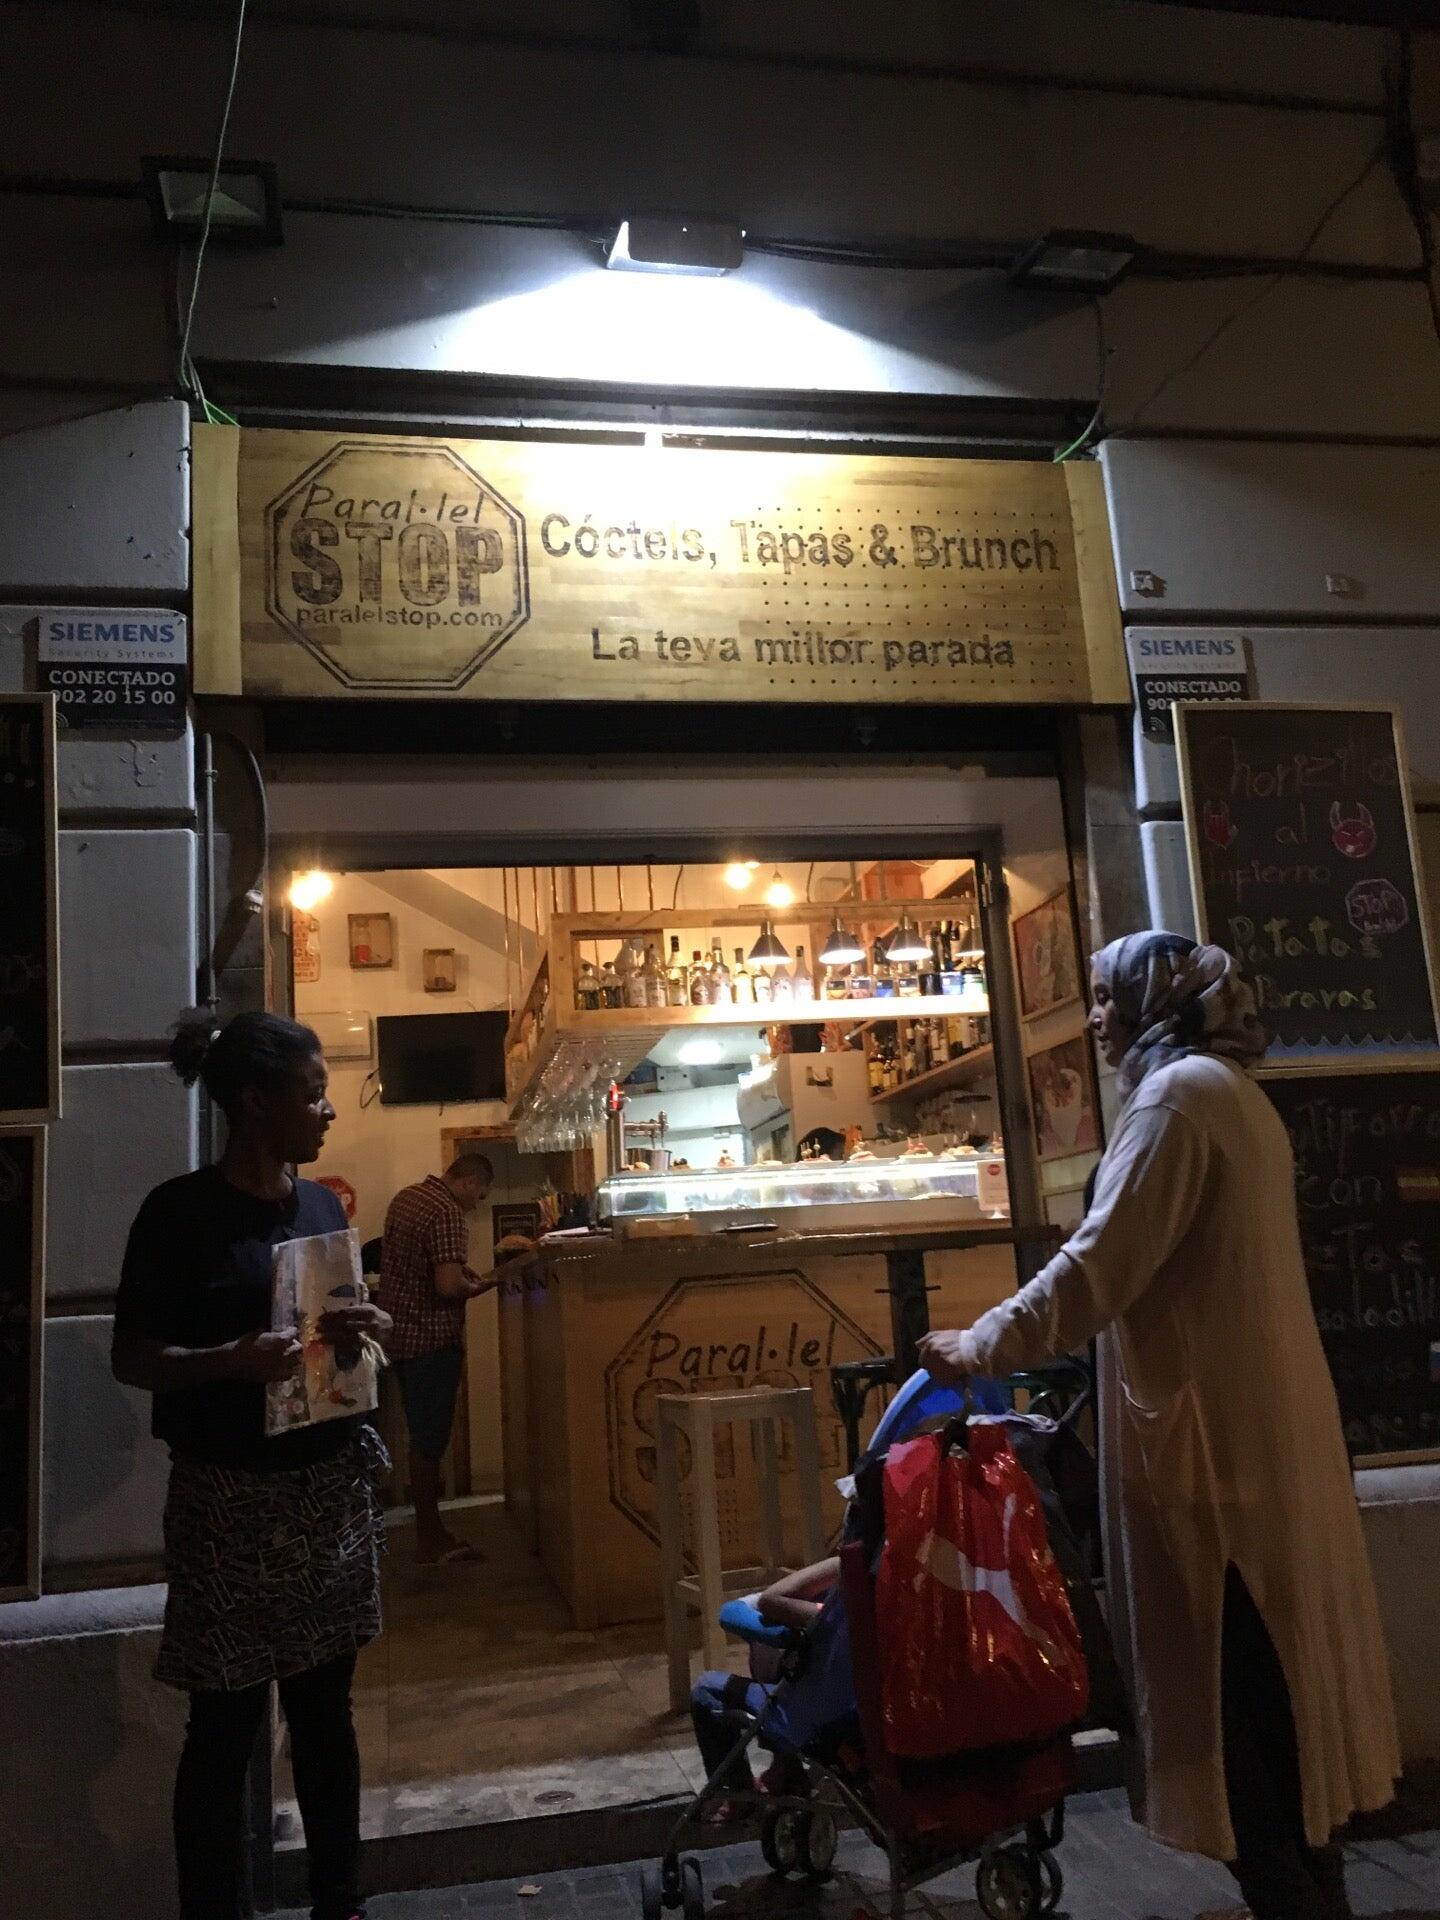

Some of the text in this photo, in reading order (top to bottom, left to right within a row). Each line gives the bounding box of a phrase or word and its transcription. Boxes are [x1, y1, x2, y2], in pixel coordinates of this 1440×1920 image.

[541, 513, 1060, 574] Cóctels, Tapas & Brunch
[290, 518, 504, 607] STOP
[296, 604, 503, 629] paralelstop.com
[50, 622, 175, 643] SIEMENS
[118, 650, 175, 659] Systems
[592, 627, 1015, 671] La teva millor parada
[1140, 639, 1236, 656] SIEMENS
[49, 670, 176, 686] CONECTADO
[1144, 681, 1242, 694] CONECTADO
[92, 690, 116, 704] 20
[124, 690, 145, 705] 15
[151, 690, 176, 705] 00
